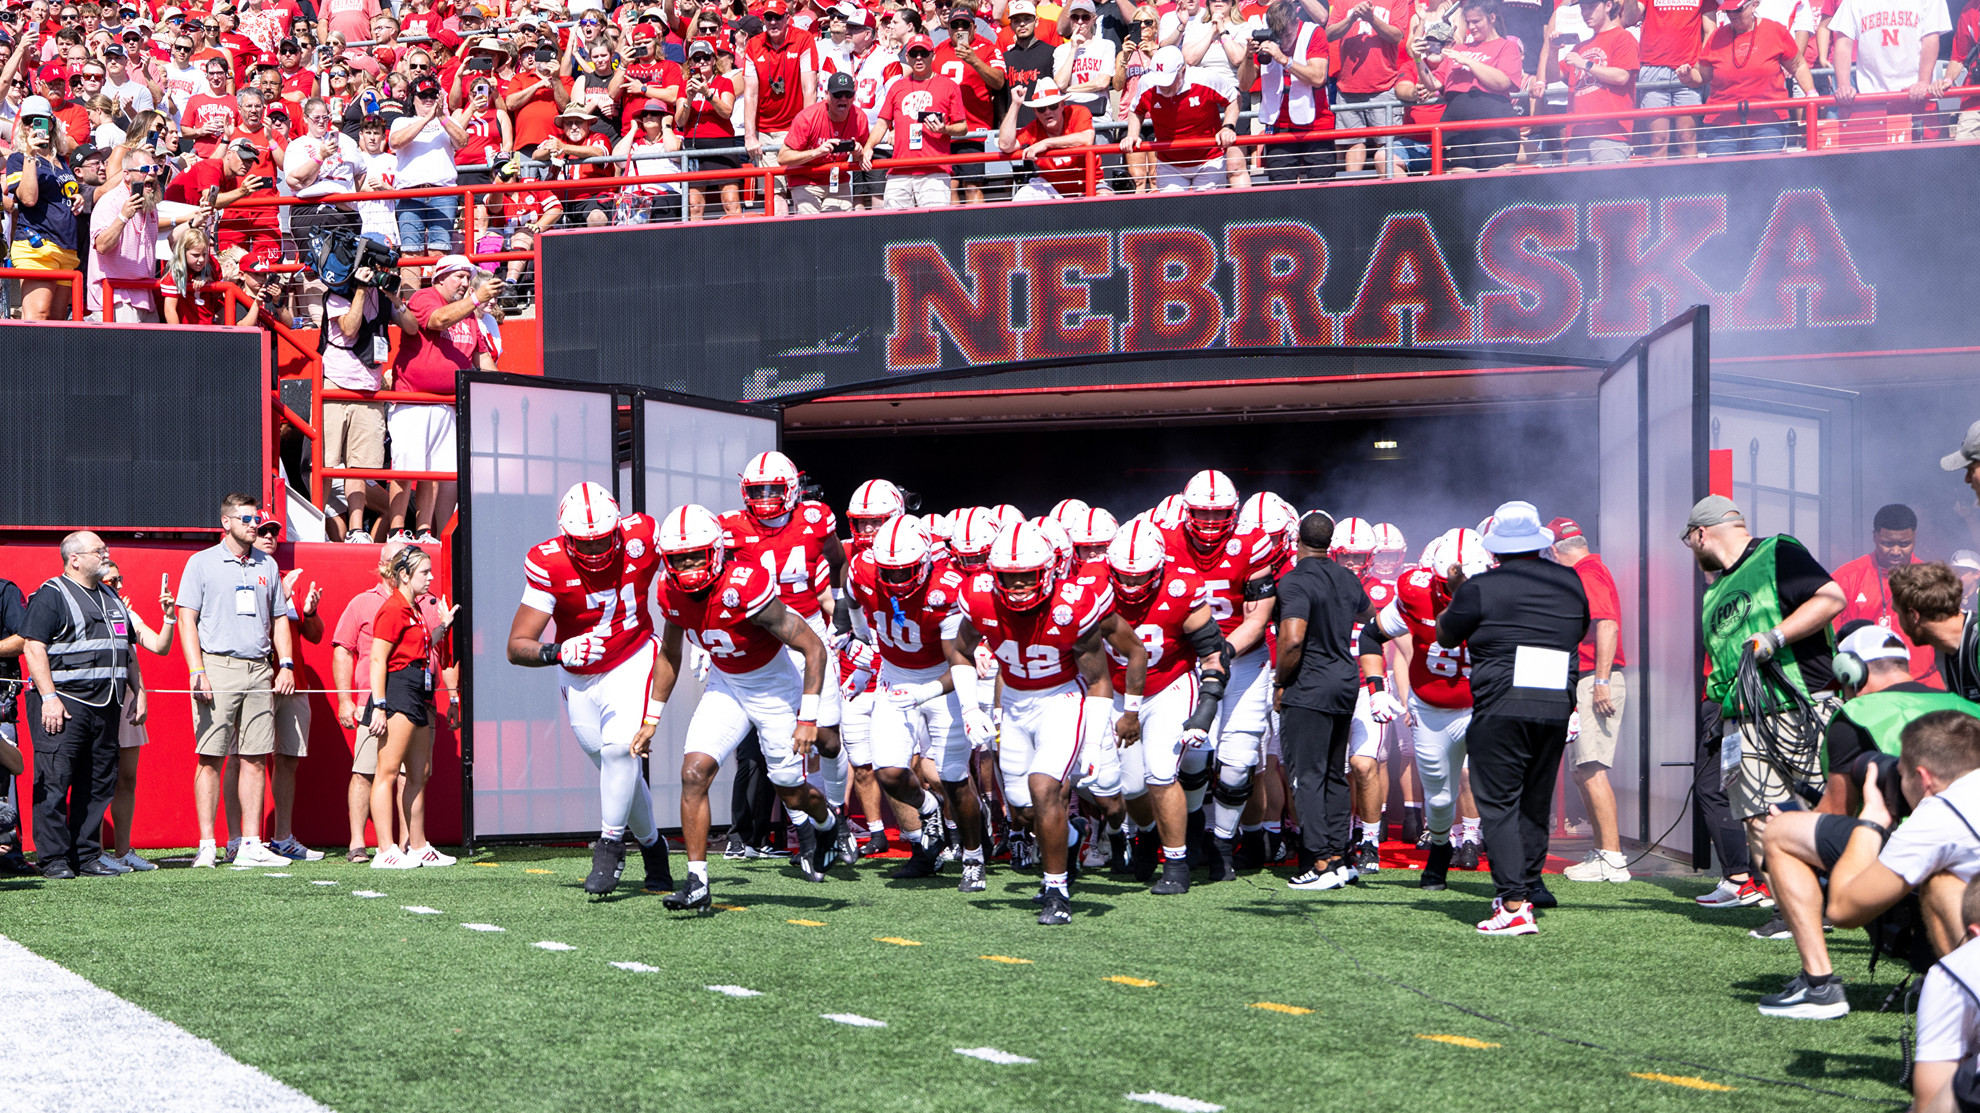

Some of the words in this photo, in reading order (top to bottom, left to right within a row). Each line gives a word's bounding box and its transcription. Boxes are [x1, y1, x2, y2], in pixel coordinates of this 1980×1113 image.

[1861, 11, 1919, 34] NEBRASKA
[1882, 29, 1899, 46] N
[260, 54, 269, 62] N
[994, 48, 1003, 59] 2
[73, 64, 80, 72] N
[1005, 65, 1041, 87] Huskers
[1156, 63, 1164, 72] N
[1076, 72, 1089, 84] N
[1188, 96, 1200, 107] N
[382, 173, 395, 187] N
[268, 248, 279, 259] N
[885, 188, 1877, 371] NEBRASKA
[261, 510, 269, 520] N
[730, 566, 754, 586] 12
[759, 545, 809, 596] 14
[939, 570, 963, 589] 10
[258, 576, 266, 586] N
[1060, 583, 1084, 605] 42
[586, 582, 639, 637] 71
[1717, 596, 1740, 624] FOX
[873, 610, 923, 653] 10
[1717, 612, 1741, 632] SPORTS
[687, 628, 747, 658] 12
[994, 640, 1062, 679] 42
